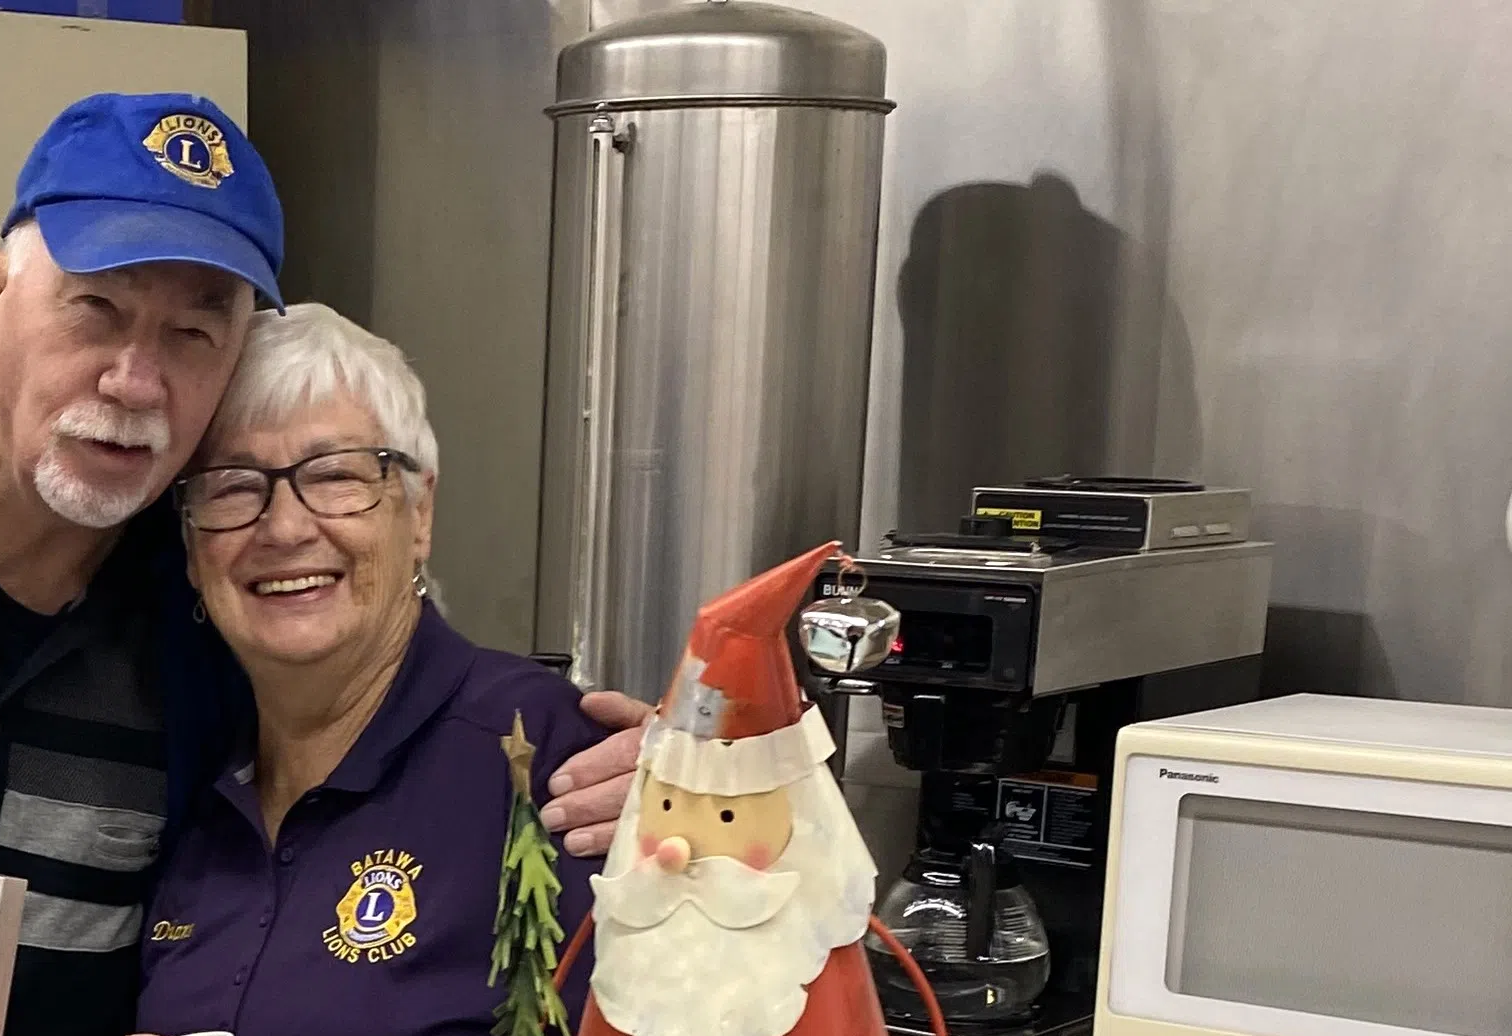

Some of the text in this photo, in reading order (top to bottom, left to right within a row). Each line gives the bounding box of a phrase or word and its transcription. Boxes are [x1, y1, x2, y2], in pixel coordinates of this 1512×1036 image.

[166, 117, 219, 142] LIONS
[179, 139, 201, 169] L
[1159, 767, 1219, 784] Panasonic
[351, 848, 423, 880] BATAWA
[364, 871, 403, 890] LIONS
[360, 892, 385, 921] L
[322, 926, 361, 963] LIONS
[367, 932, 417, 964] CLUB
